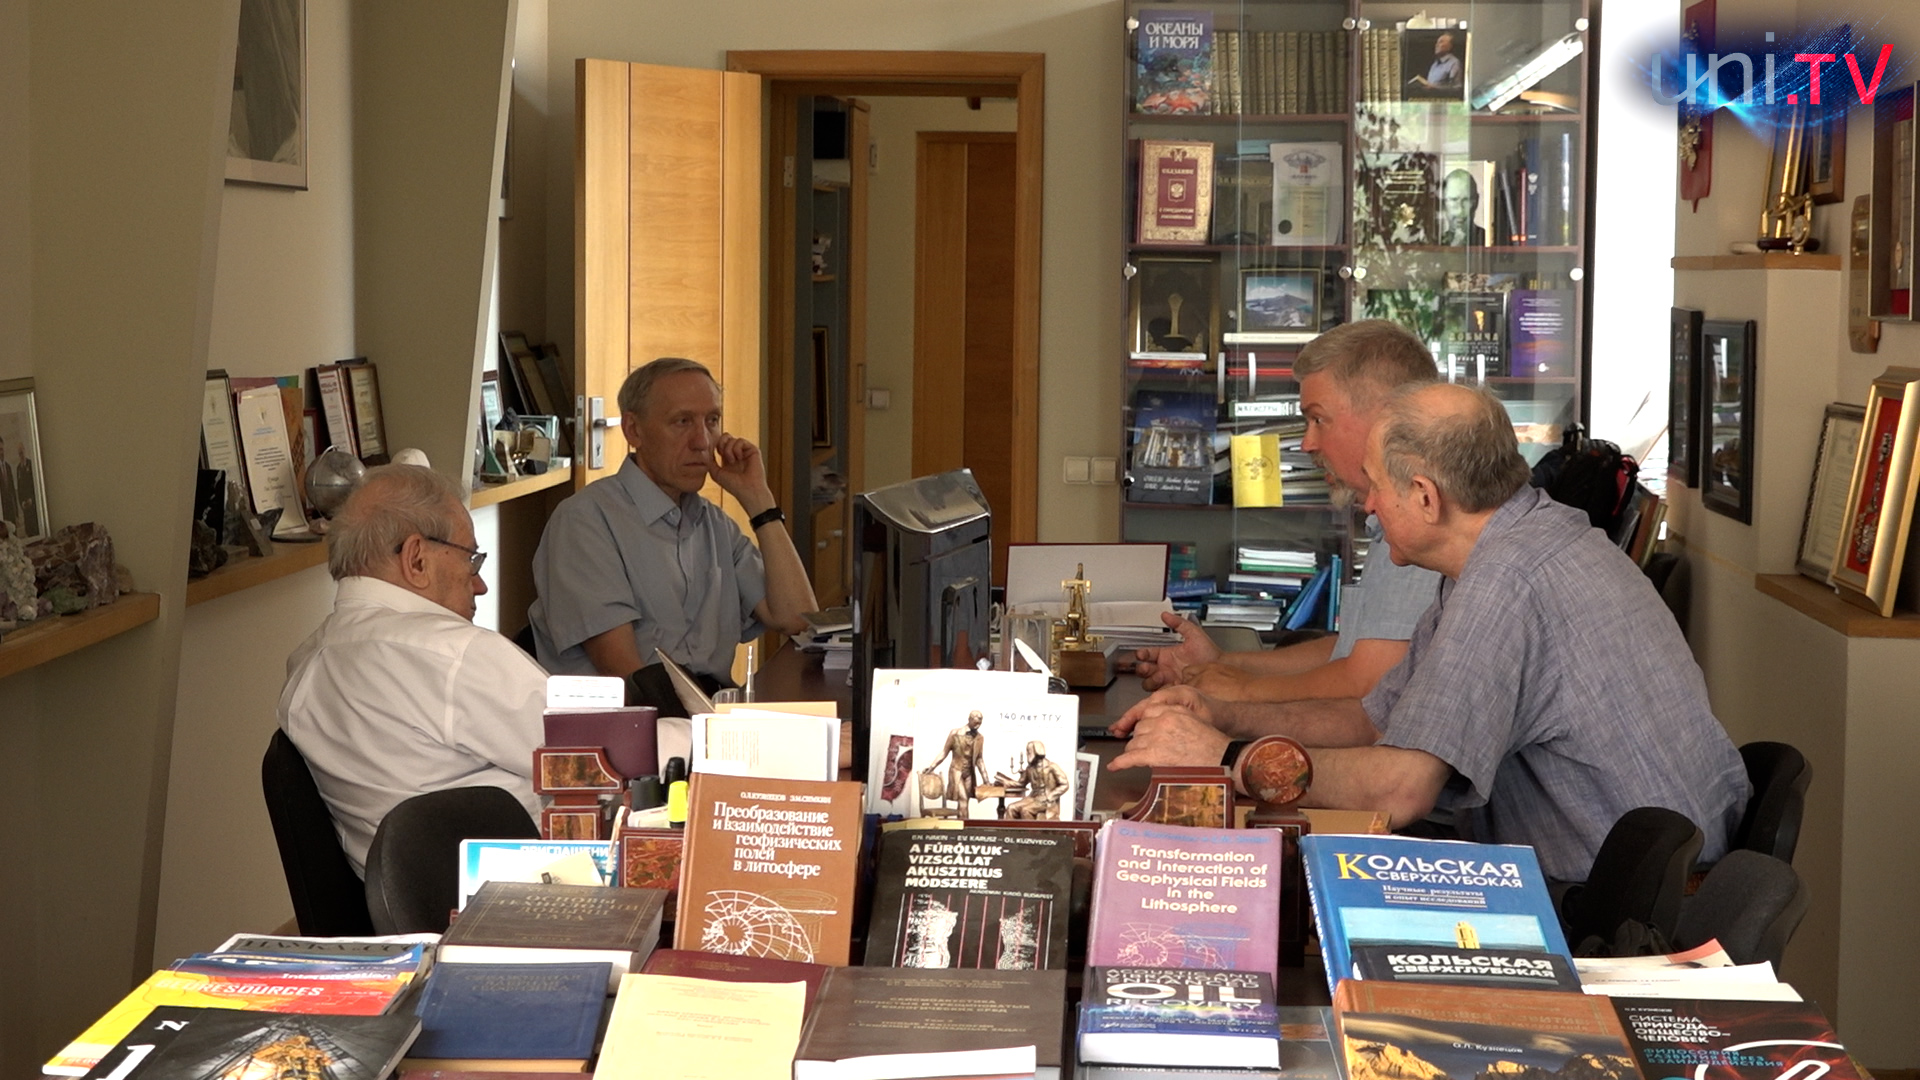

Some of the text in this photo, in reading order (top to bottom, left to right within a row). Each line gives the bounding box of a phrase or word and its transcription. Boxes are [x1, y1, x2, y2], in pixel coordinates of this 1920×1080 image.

[1145, 22, 1203, 36] ОКЕАНЫ
[1149, 36, 1200, 49] И МОРЯ
[1000, 712, 1017, 721] 140
[1042, 713, 1062, 722] ТГУ
[713, 801, 829, 824] Преобразование
[712, 818, 834, 837] и взаимодействие
[735, 833, 842, 851] геофизических
[909, 844, 921, 853] A
[734, 847, 775, 861] полей
[909, 853, 993, 866] VIZSGÁLAT
[1131, 844, 1255, 862] Transformation
[733, 859, 821, 879] в литосфере
[906, 866, 1003, 879] AKUSZTIKUS
[1117, 859, 1268, 875] and Interaction of
[1333, 852, 1521, 880] КОЛЬСКАЯ
[904, 876, 989, 889] MÓDSZERE
[1116, 870, 1267, 888] Geophysical Fields
[1375, 870, 1523, 888] СВЕРХГЛУБОКАЯ
[1187, 888, 1214, 899] the
[1141, 898, 1238, 914] Lithosphere
[1386, 954, 1553, 970] КОЛЬСКАЯ
[1392, 965, 1556, 978] СВЕРХГЛУБОКАЯ
[155, 979, 325, 996] GEORESOURCES
[1106, 983, 1262, 1003] OIL
[1106, 997, 1261, 1010] RECOVERY
[1628, 1014, 1702, 1023] СИСТЕМА
[1637, 1035, 1710, 1044] ЧЕЛОВЕК
